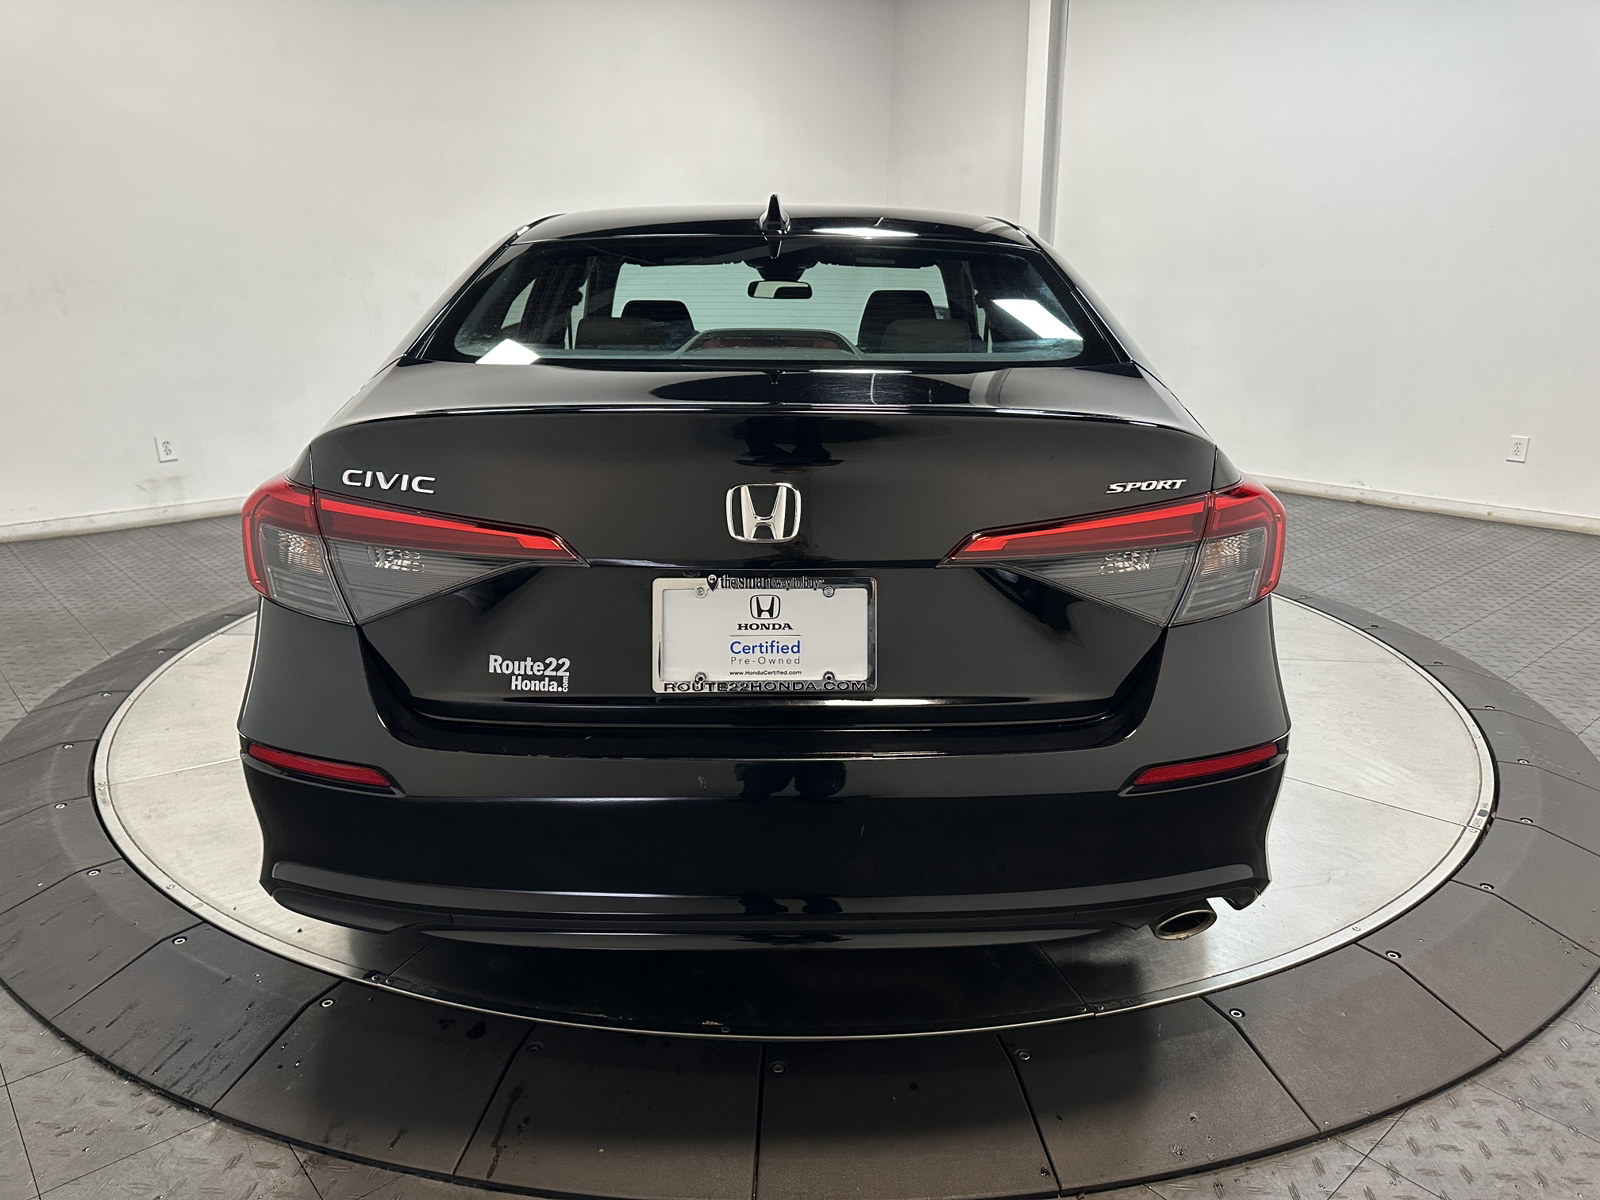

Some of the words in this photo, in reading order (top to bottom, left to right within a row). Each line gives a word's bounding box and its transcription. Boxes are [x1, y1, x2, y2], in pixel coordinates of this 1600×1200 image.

[342, 469, 436, 494] CIVIC
[1105, 479, 1187, 494] SPORT
[737, 623, 793, 631] HONDA
[730, 640, 801, 655] Certified
[488, 654, 571, 676] Route22
[730, 656, 801, 665] Pre-Owned
[663, 681, 867, 692] ROUTE22HONDA.COM
